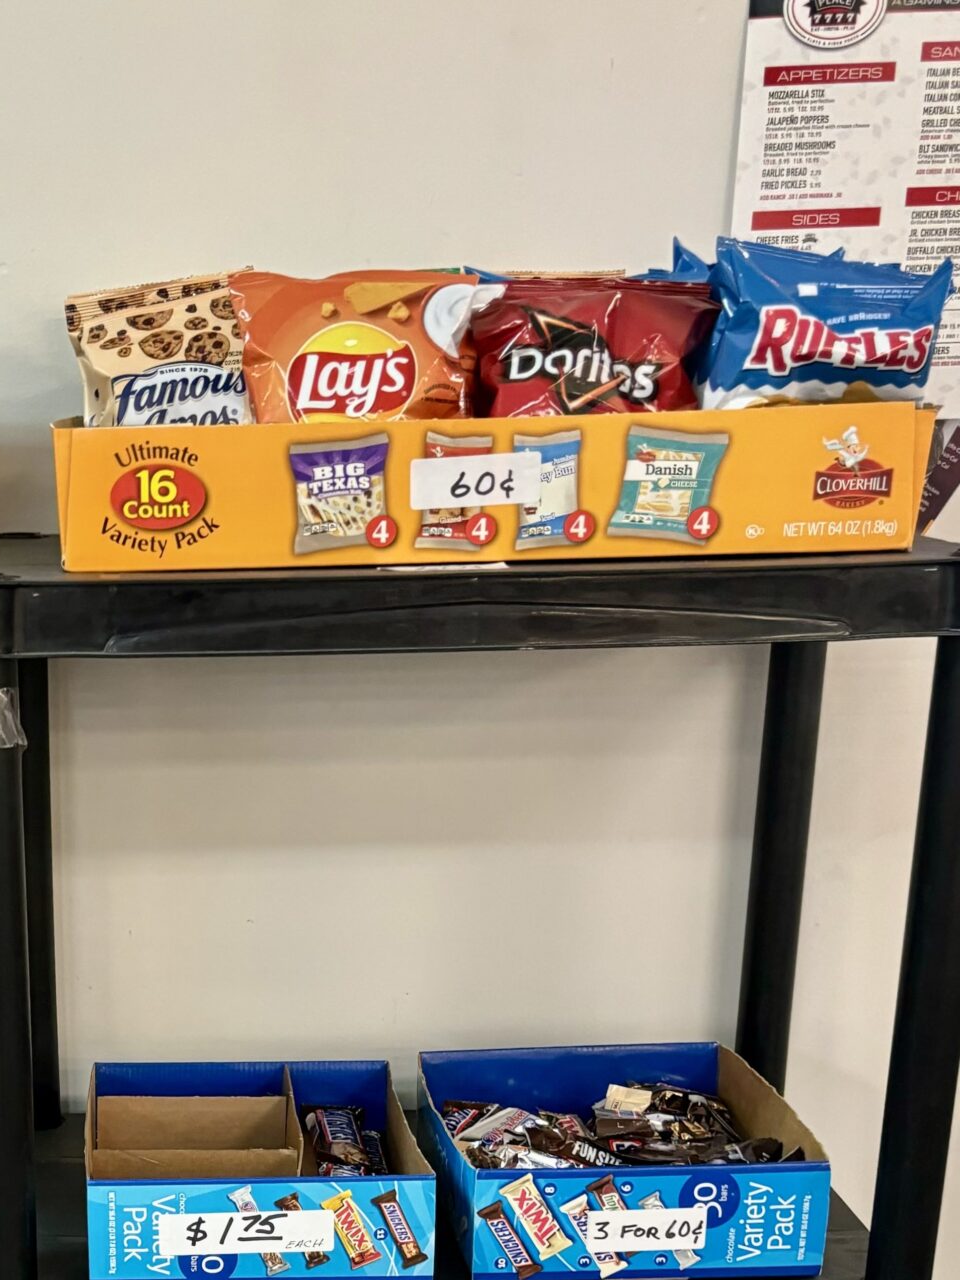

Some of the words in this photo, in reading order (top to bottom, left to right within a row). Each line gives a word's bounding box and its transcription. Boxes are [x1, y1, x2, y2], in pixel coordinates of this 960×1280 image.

[777, 67, 882, 83] APPETIZERS
[926, 67, 951, 77] ITALIAN
[768, 89, 809, 100] MOZZARELLA
[811, 89, 825, 99] STIX
[925, 80, 950, 90] ITALIAN
[924, 93, 948, 103] ITALIAN
[800, 115, 830, 126] POPPERS
[923, 106, 955, 116] MEATBALL
[921, 119, 948, 128] GRILLED
[764, 142, 793, 152] BREADED
[794, 140, 836, 151] MUSHROOMS
[761, 168, 785, 178] GARLIC
[786, 167, 807, 177] BREAD
[760, 181, 780, 190] FRIED
[780, 179, 807, 190] PICKLES
[792, 213, 840, 225] SIDES
[911, 210, 938, 220] CHICKEN
[756, 236, 779, 246] CHEESE
[781, 234, 800, 245] FRIES
[920, 227, 948, 237] CHICKEN
[907, 246, 935, 256] BUFFALO
[160, 367, 186, 375] SINCE
[508, 346, 656, 399] Doritos
[297, 349, 407, 419] Lay's
[112, 372, 247, 427] Famous
[114, 441, 199, 468] Ultimate
[313, 462, 365, 481] BIG
[554, 465, 576, 479] Bun
[645, 464, 693, 476] Danish
[136, 469, 178, 503] 16
[309, 476, 371, 495] TEXAS
[450, 468, 515, 499] 60¢
[670, 480, 698, 488] CHEESE
[816, 475, 888, 494] CLOVERHILL
[122, 500, 190, 520] Count
[372, 520, 389, 543] 4
[471, 518, 489, 540] 4
[570, 514, 587, 538] 4
[693, 511, 710, 535] 4
[783, 522, 805, 537] NET
[807, 522, 826, 536] WT
[827, 521, 842, 535] 64
[844, 521, 859, 535] OZ
[862, 519, 898, 538] (1.8kg)
[100, 517, 168, 558] Variety
[175, 519, 220, 550] Pack
[572, 1140, 597, 1163] FUN
[718, 1184, 729, 1202] bars
[334, 1200, 371, 1251] TWIX
[384, 1203, 411, 1243] SNICKERS
[513, 1188, 550, 1249] TWIX
[736, 1181, 774, 1262] Variety
[767, 1194, 797, 1250] Pack
[123, 1207, 149, 1263] Pack
[593, 1222, 610, 1240] 3
[620, 1224, 660, 1240] FOR
[665, 1220, 704, 1244] 60¢
[285, 1238, 326, 1250] EACH
[490, 1219, 529, 1265] SNICKERS
[725, 1227, 736, 1263] chocolate
